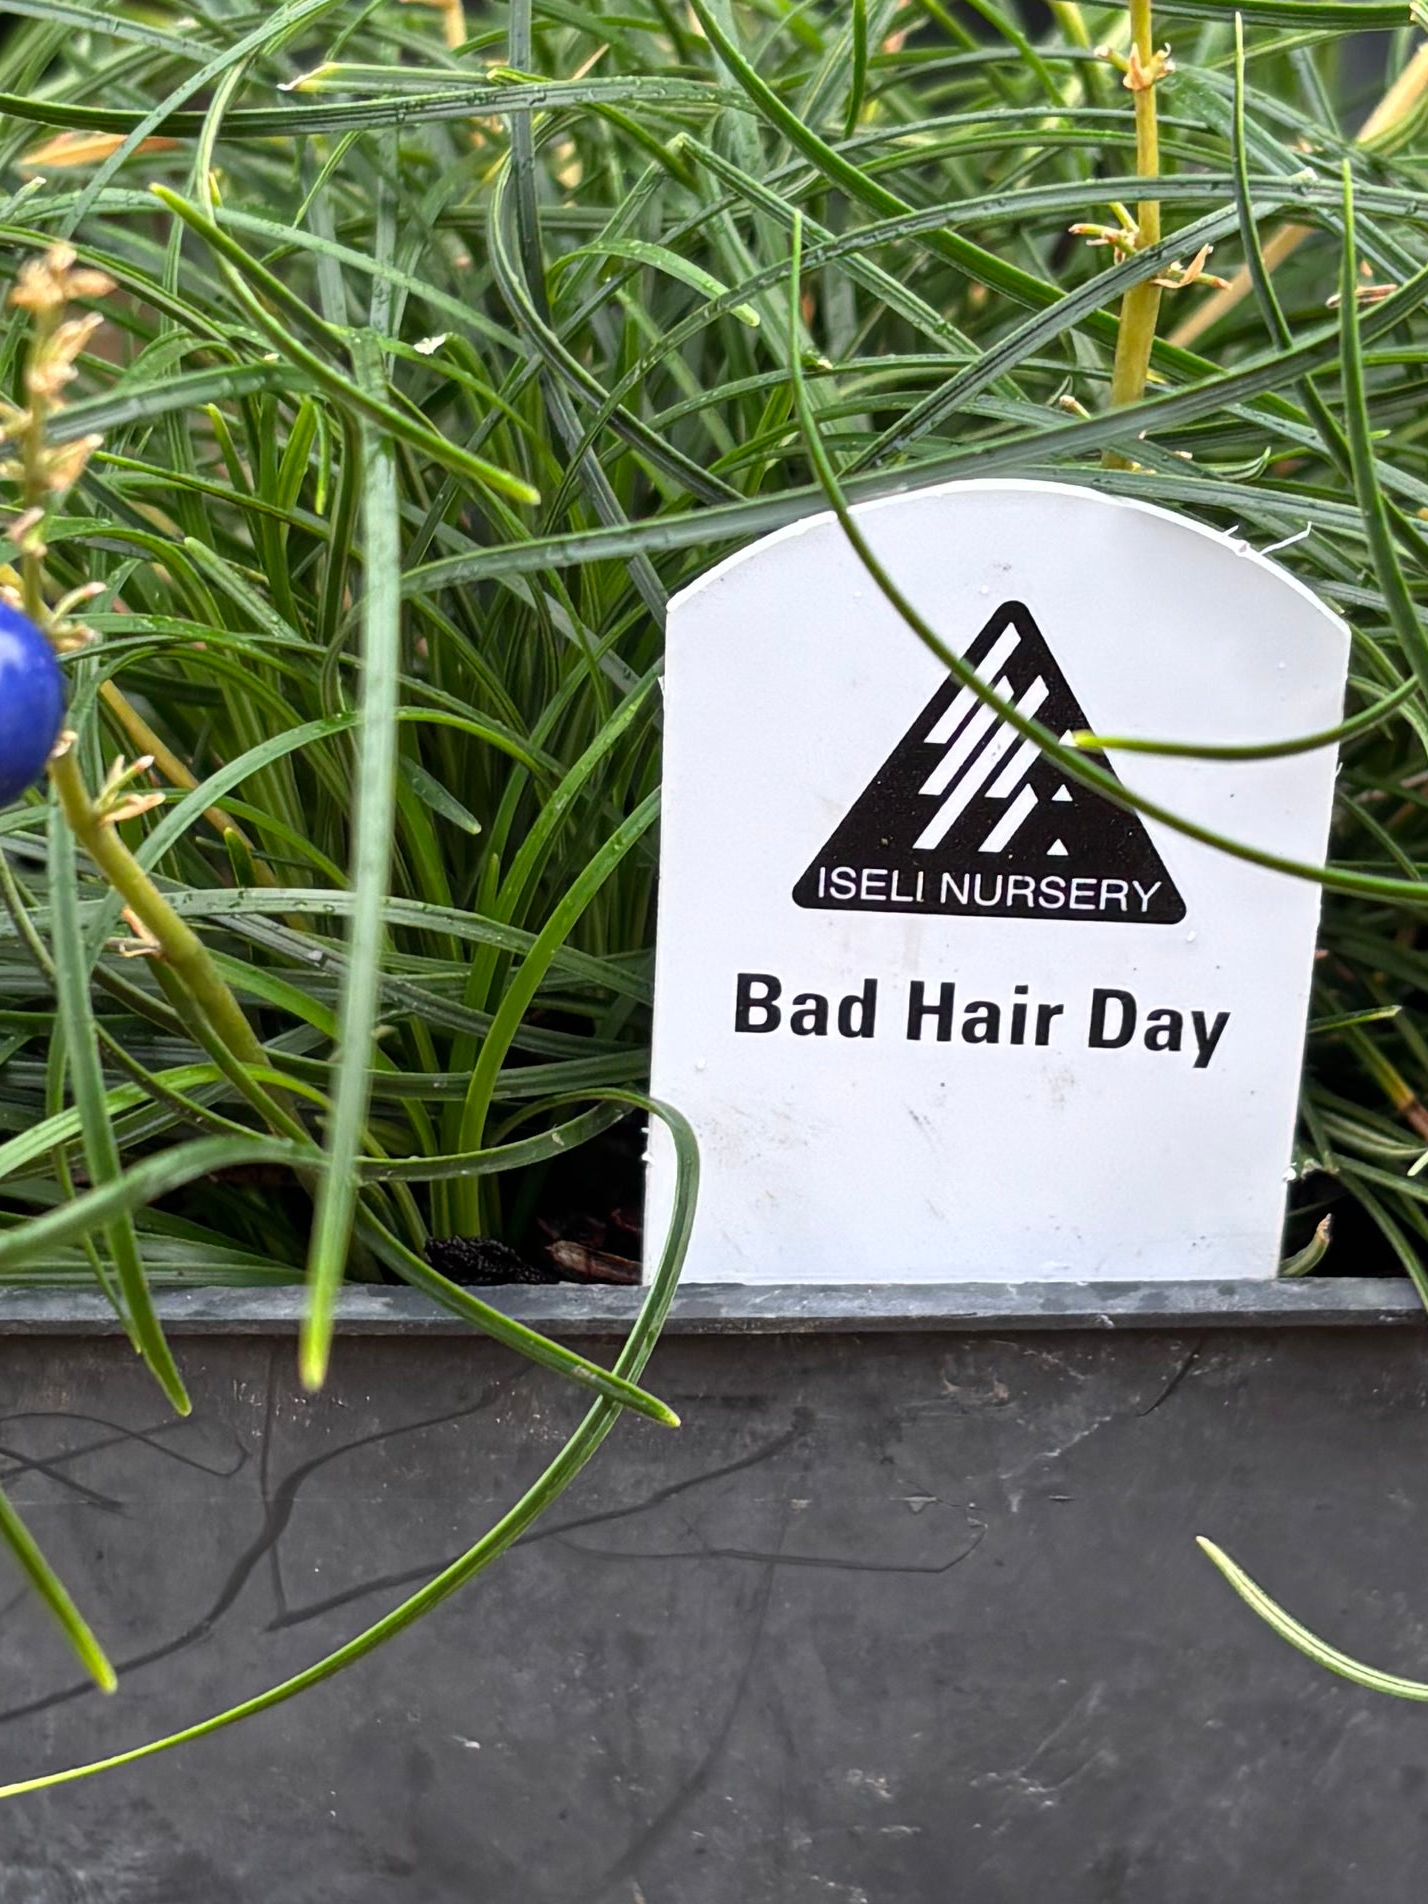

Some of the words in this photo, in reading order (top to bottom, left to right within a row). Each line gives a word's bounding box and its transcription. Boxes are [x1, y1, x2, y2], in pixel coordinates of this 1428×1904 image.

[818, 866, 924, 903] ISELI
[940, 872, 1162, 913] NURSERY
[734, 972, 878, 1039] Bad
[906, 980, 1064, 1047] Hair
[1088, 988, 1230, 1069] Day
